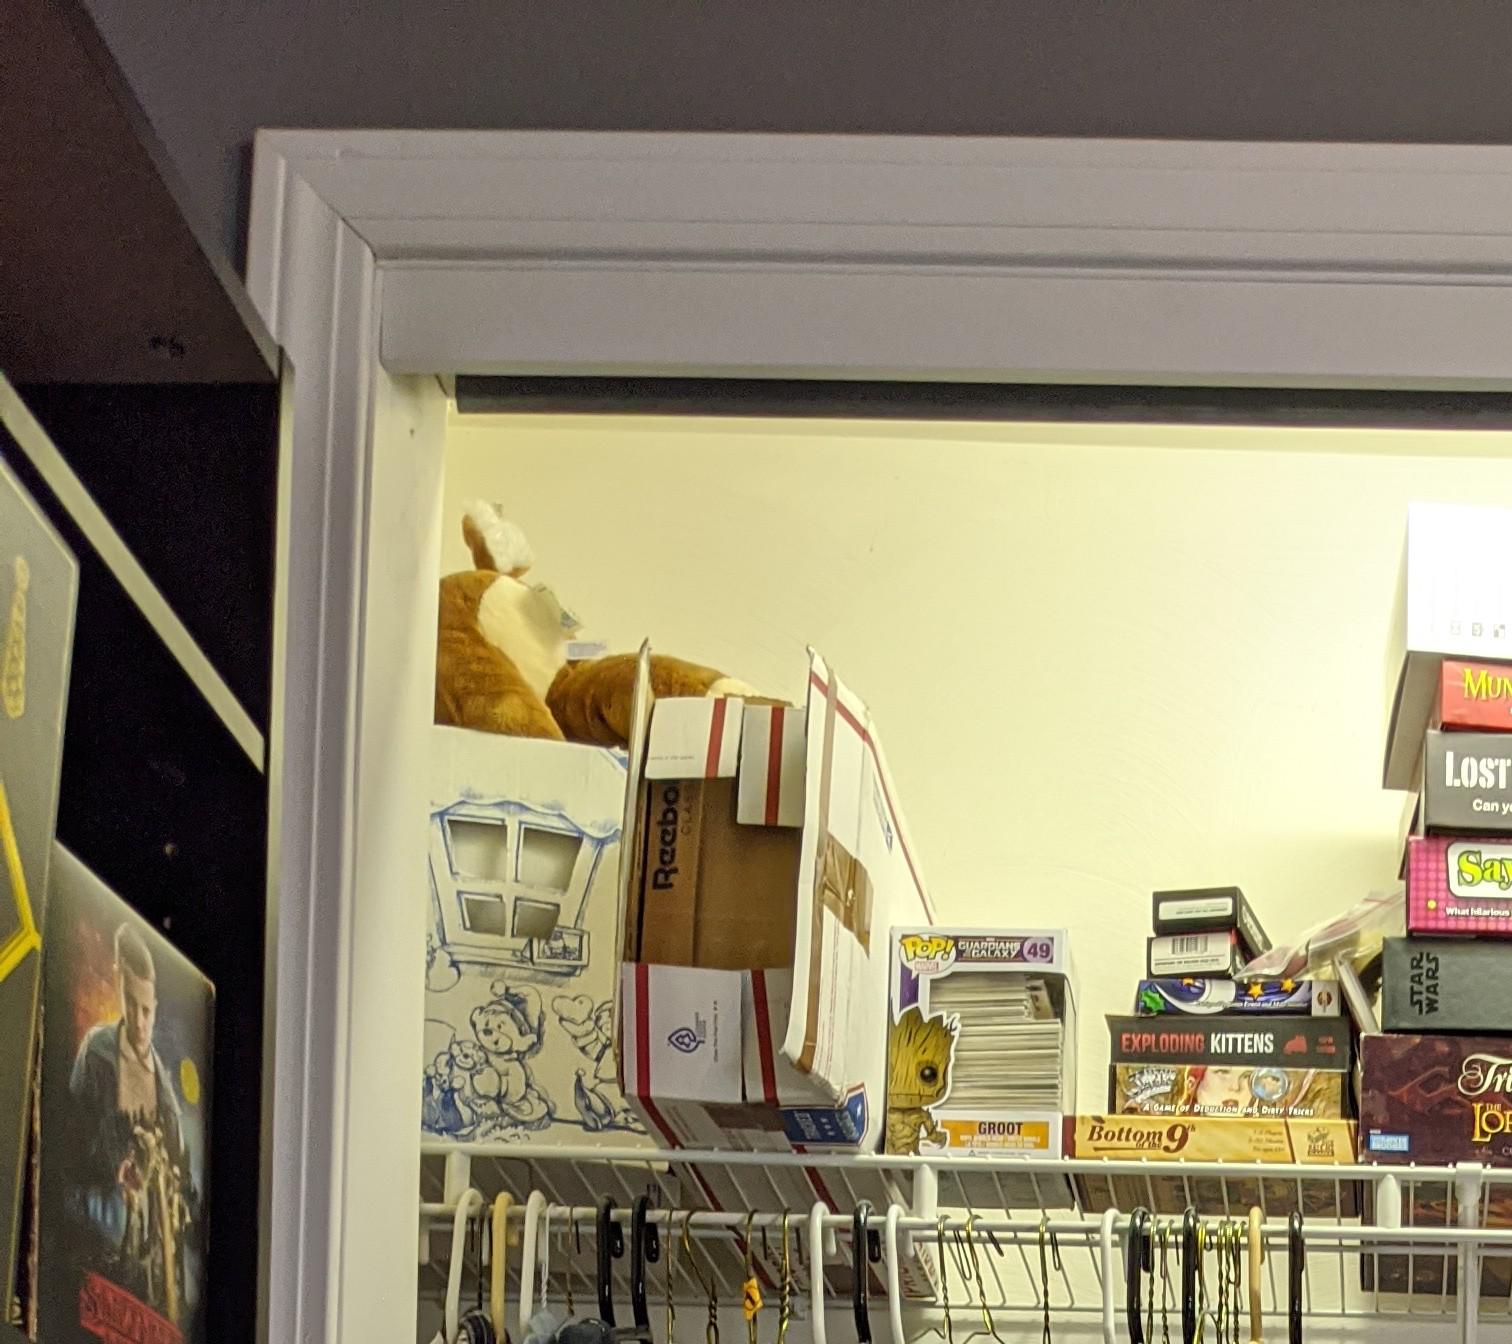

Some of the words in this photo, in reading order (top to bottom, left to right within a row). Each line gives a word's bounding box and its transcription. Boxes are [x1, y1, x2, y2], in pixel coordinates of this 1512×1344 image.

[1445, 751, 1511, 789] LOST
[1472, 799, 1499, 813] Can
[651, 783, 681, 891] Reebo
[1446, 906, 1470, 916] What
[1470, 907, 1509, 917] hilarious
[901, 935, 954, 962] POP!
[958, 940, 1020, 950] GUARDIANS
[1027, 942, 1051, 958] 49
[971, 949, 1018, 958] GALAXY
[1410, 952, 1425, 1015] STAR
[1425, 952, 1439, 1014] WARS
[1121, 1032, 1205, 1053] EXPLODING
[1210, 1033, 1274, 1054] KITTENS
[1143, 1103, 1150, 1111] A
[1153, 1104, 1176, 1112] GAME
[1178, 1104, 1190, 1113] OF
[1261, 1106, 1283, 1116] DIRTY
[1288, 1107, 1315, 1117] TRICKS
[1486, 1103, 1502, 1111] THE
[978, 1121, 1023, 1135] GROOT
[1087, 1122, 1163, 1142] Bottom
